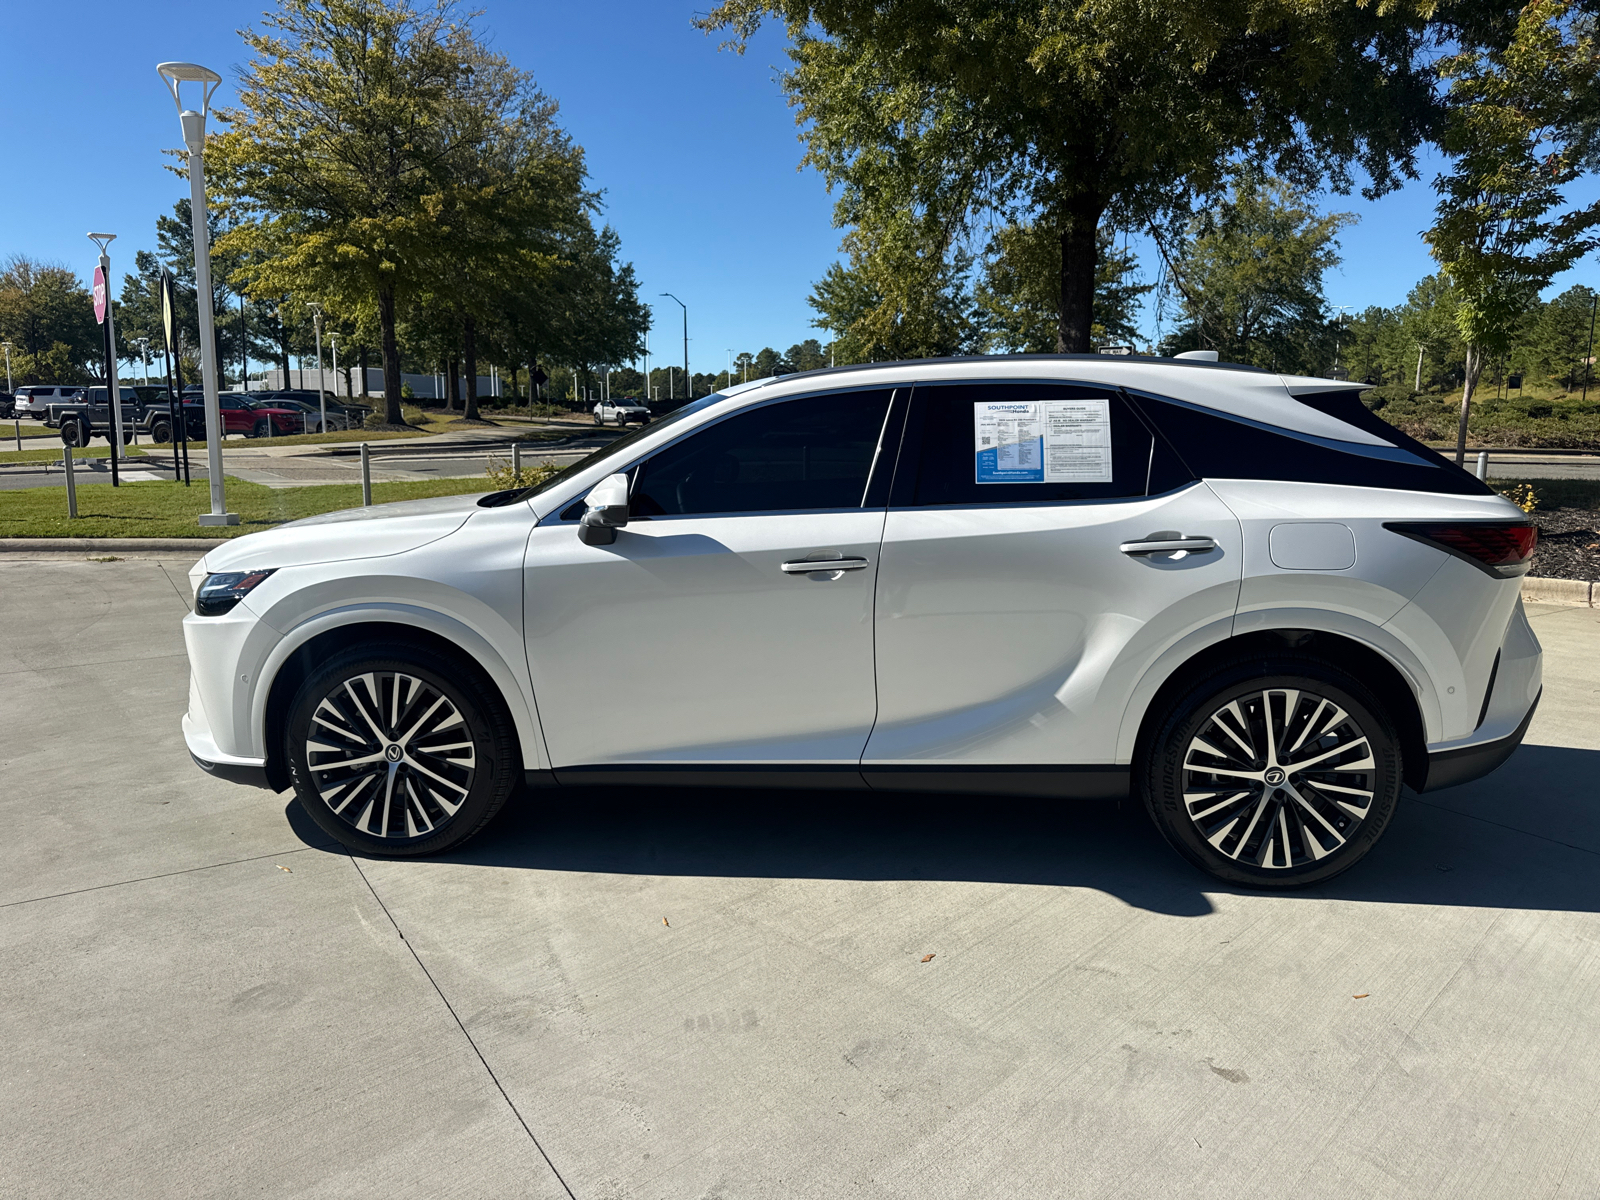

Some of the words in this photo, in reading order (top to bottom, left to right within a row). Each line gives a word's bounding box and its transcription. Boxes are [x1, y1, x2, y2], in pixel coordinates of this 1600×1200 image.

[94, 283, 105, 306] STOP
[1161, 714, 1196, 812] BRIDGESTONE
[1362, 746, 1397, 846] BRIDGESTONE
